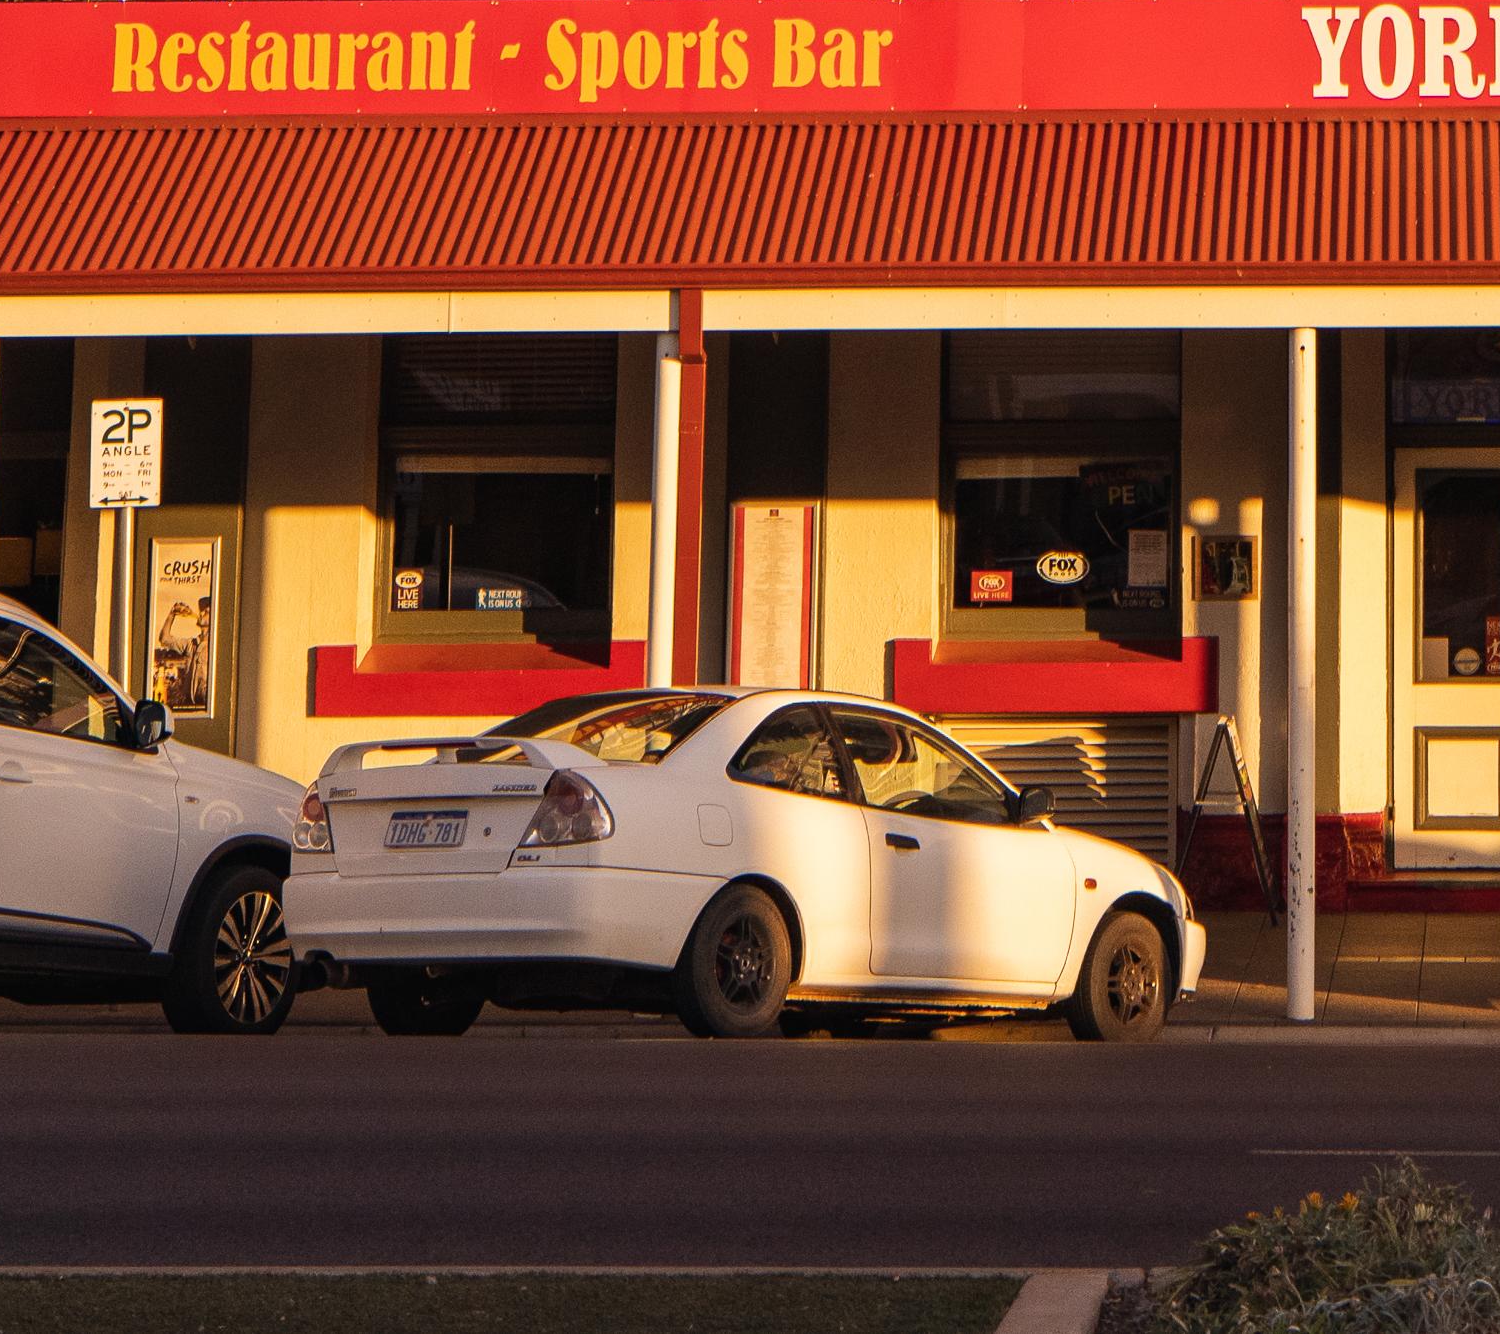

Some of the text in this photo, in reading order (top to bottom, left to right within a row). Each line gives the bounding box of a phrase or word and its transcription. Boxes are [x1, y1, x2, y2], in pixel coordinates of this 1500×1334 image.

[111, 20, 477, 93] Restaurant
[543, 17, 749, 103] Sports
[772, 18, 894, 89] Bar
[101, 408, 152, 444] 2P
[101, 445, 152, 457] ANGLE
[103, 470, 122, 478] MON
[138, 469, 151, 477] FRI
[118, 490, 133, 498] SAT
[163, 559, 211, 576] CRUSH
[1048, 558, 1078, 573] FOX
[173, 575, 202, 585] THIRST
[400, 576, 418, 586] FOX
[983, 577, 1000, 588] FOX
[397, 588, 420, 600] LIVE
[488, 589, 505, 599] NEXT
[973, 591, 1009, 599] LIVE HERE
[397, 600, 420, 610] HERE
[494, 599, 504, 609] ON
[504, 599, 514, 609] US
[390, 822, 461, 844] 1DHG 781
